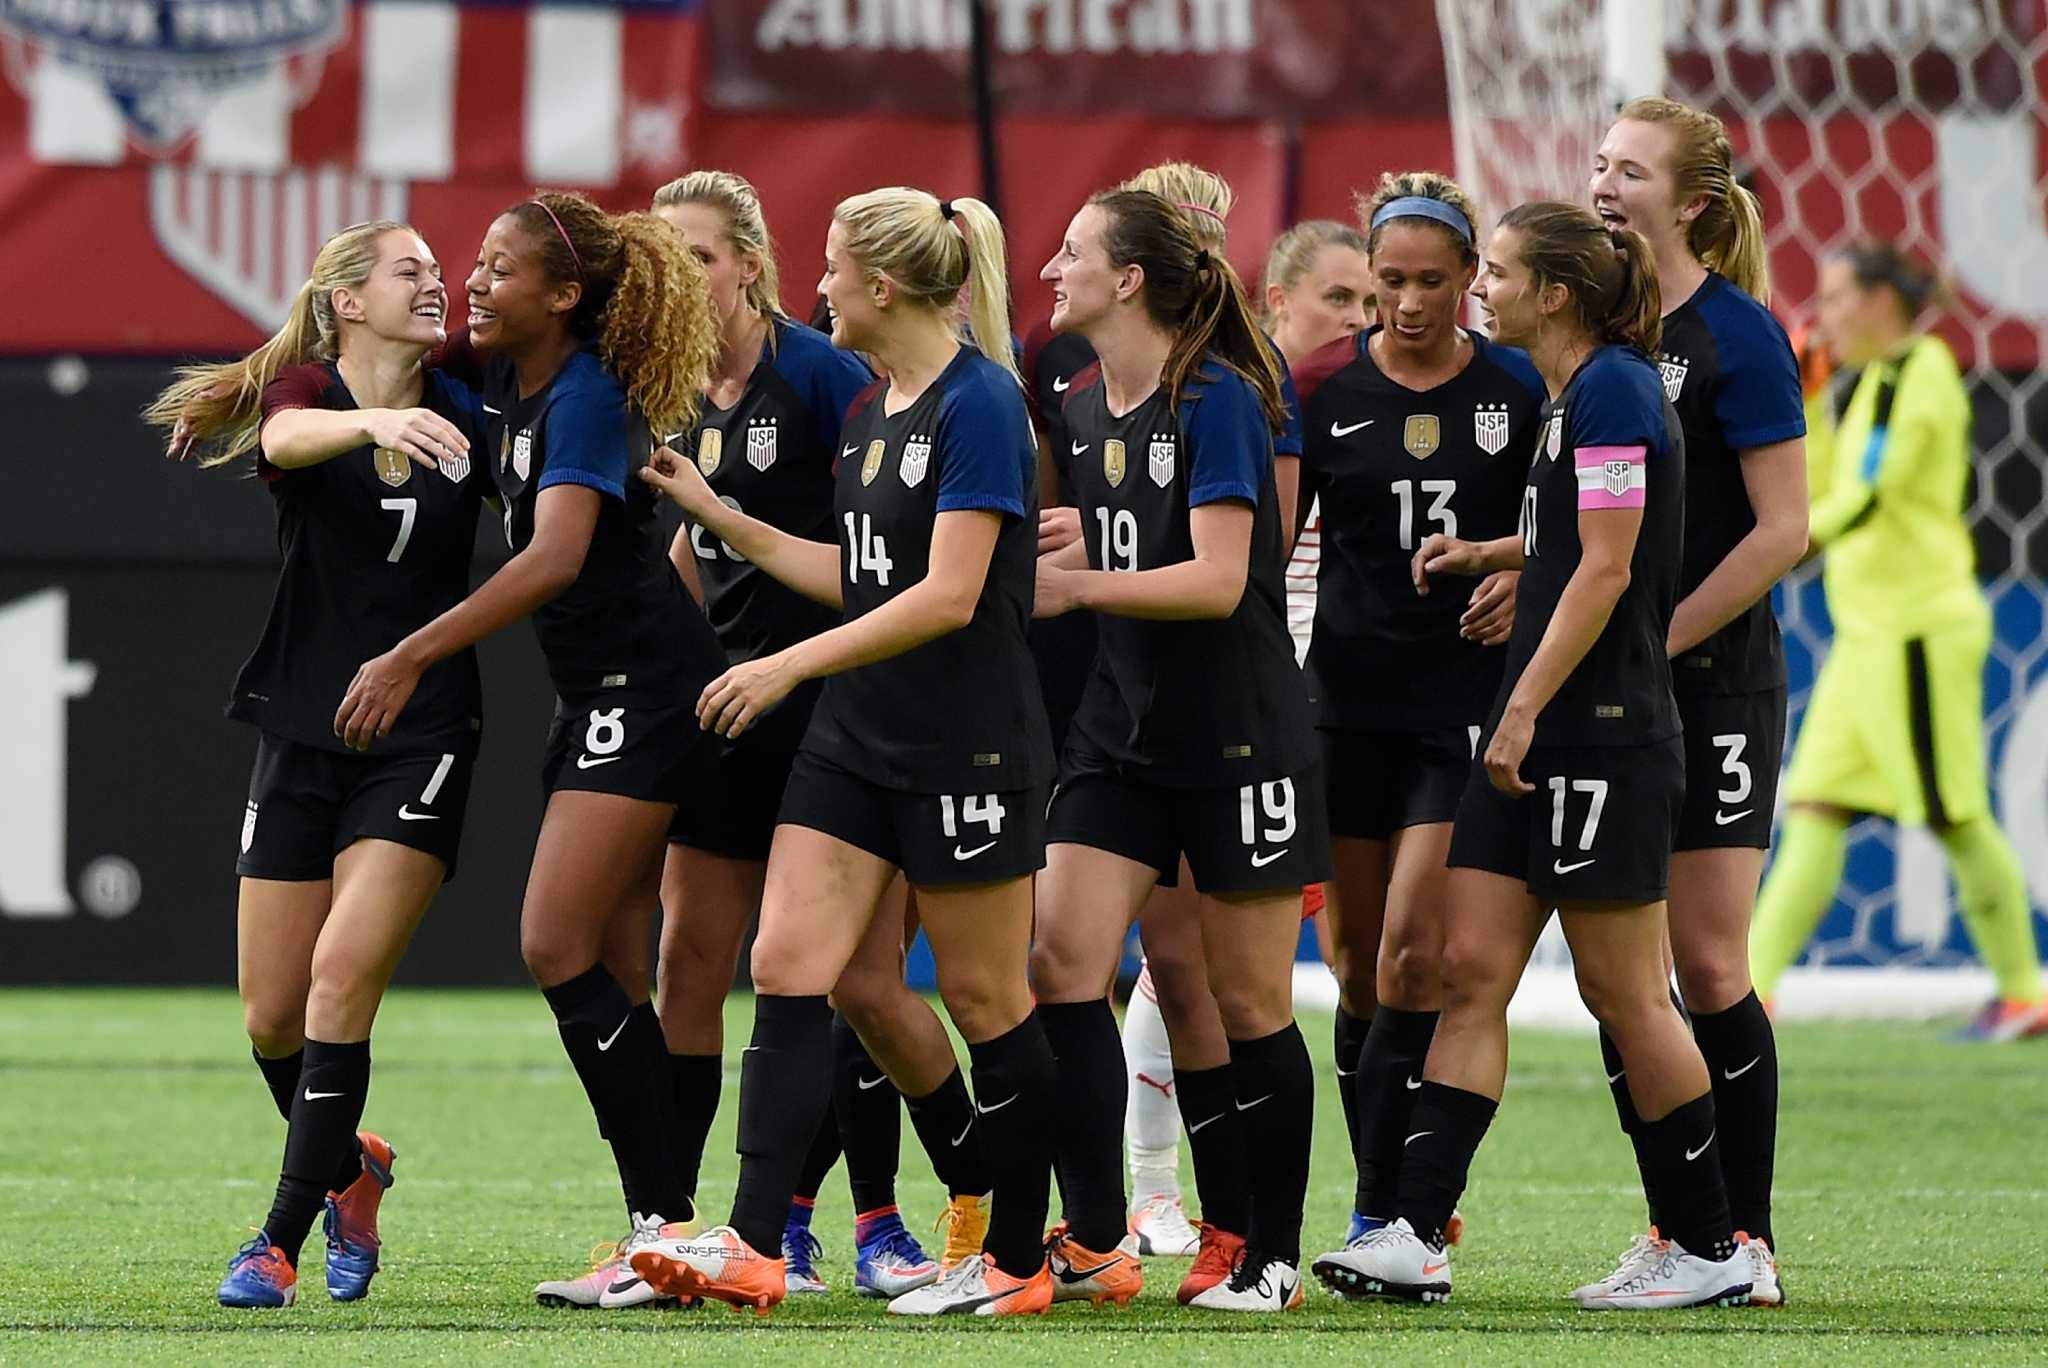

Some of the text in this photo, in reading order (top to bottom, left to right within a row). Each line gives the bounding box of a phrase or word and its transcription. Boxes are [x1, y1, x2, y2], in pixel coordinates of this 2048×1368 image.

[750, 429, 775, 446] USA
[1476, 413, 1507, 431] USA
[905, 445, 929, 462] USA
[1151, 445, 1174, 463] USA
[1606, 463, 1629, 476] USA
[380, 498, 418, 563] 7
[1095, 506, 1138, 572] 19
[1391, 479, 1458, 550] 13
[844, 511, 894, 586] 14
[585, 707, 626, 755] 8
[1712, 733, 1753, 804] 3
[940, 793, 1006, 837] 14
[1240, 776, 1297, 844] 19
[1548, 775, 1609, 851] 17
